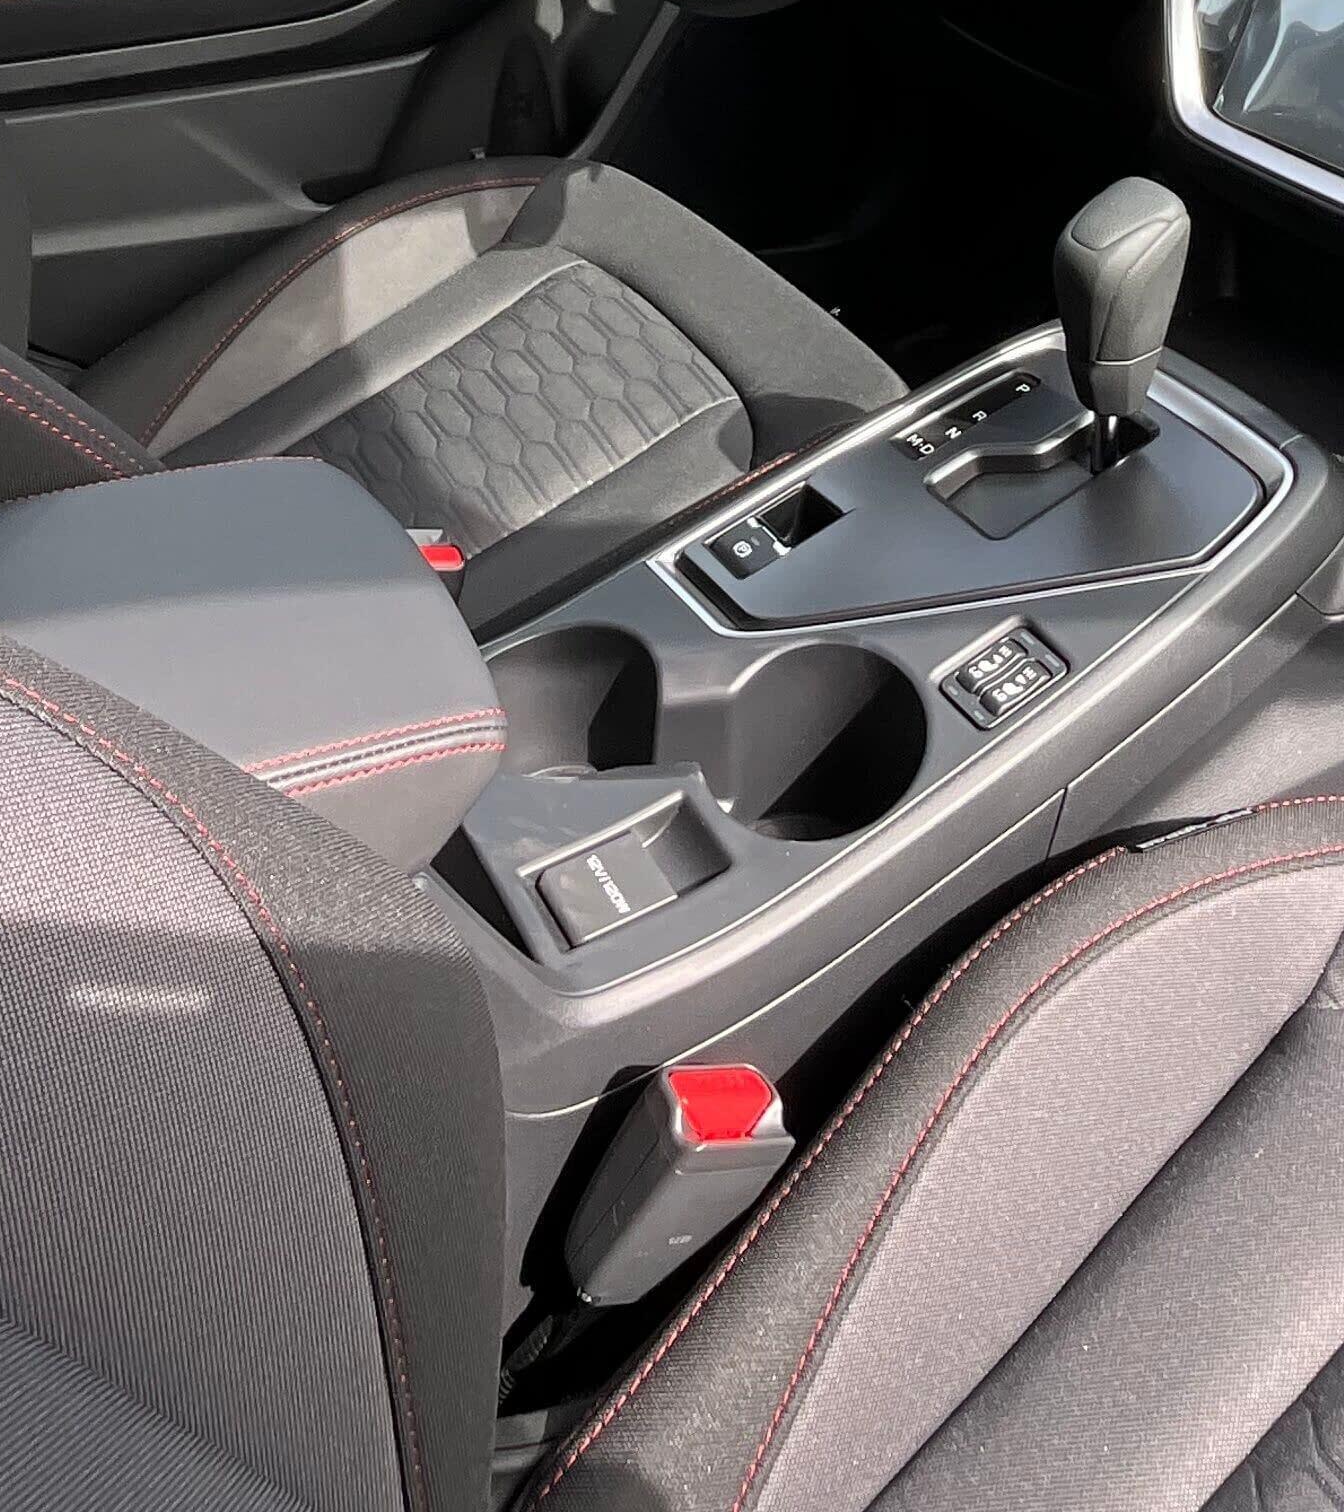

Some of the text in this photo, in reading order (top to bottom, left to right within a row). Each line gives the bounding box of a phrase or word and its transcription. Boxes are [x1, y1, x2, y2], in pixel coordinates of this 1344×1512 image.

[1015, 383, 1031, 393] P
[972, 410, 988, 421] R
[944, 426, 962, 439] N
[586, 854, 631, 914] 12V/120W
